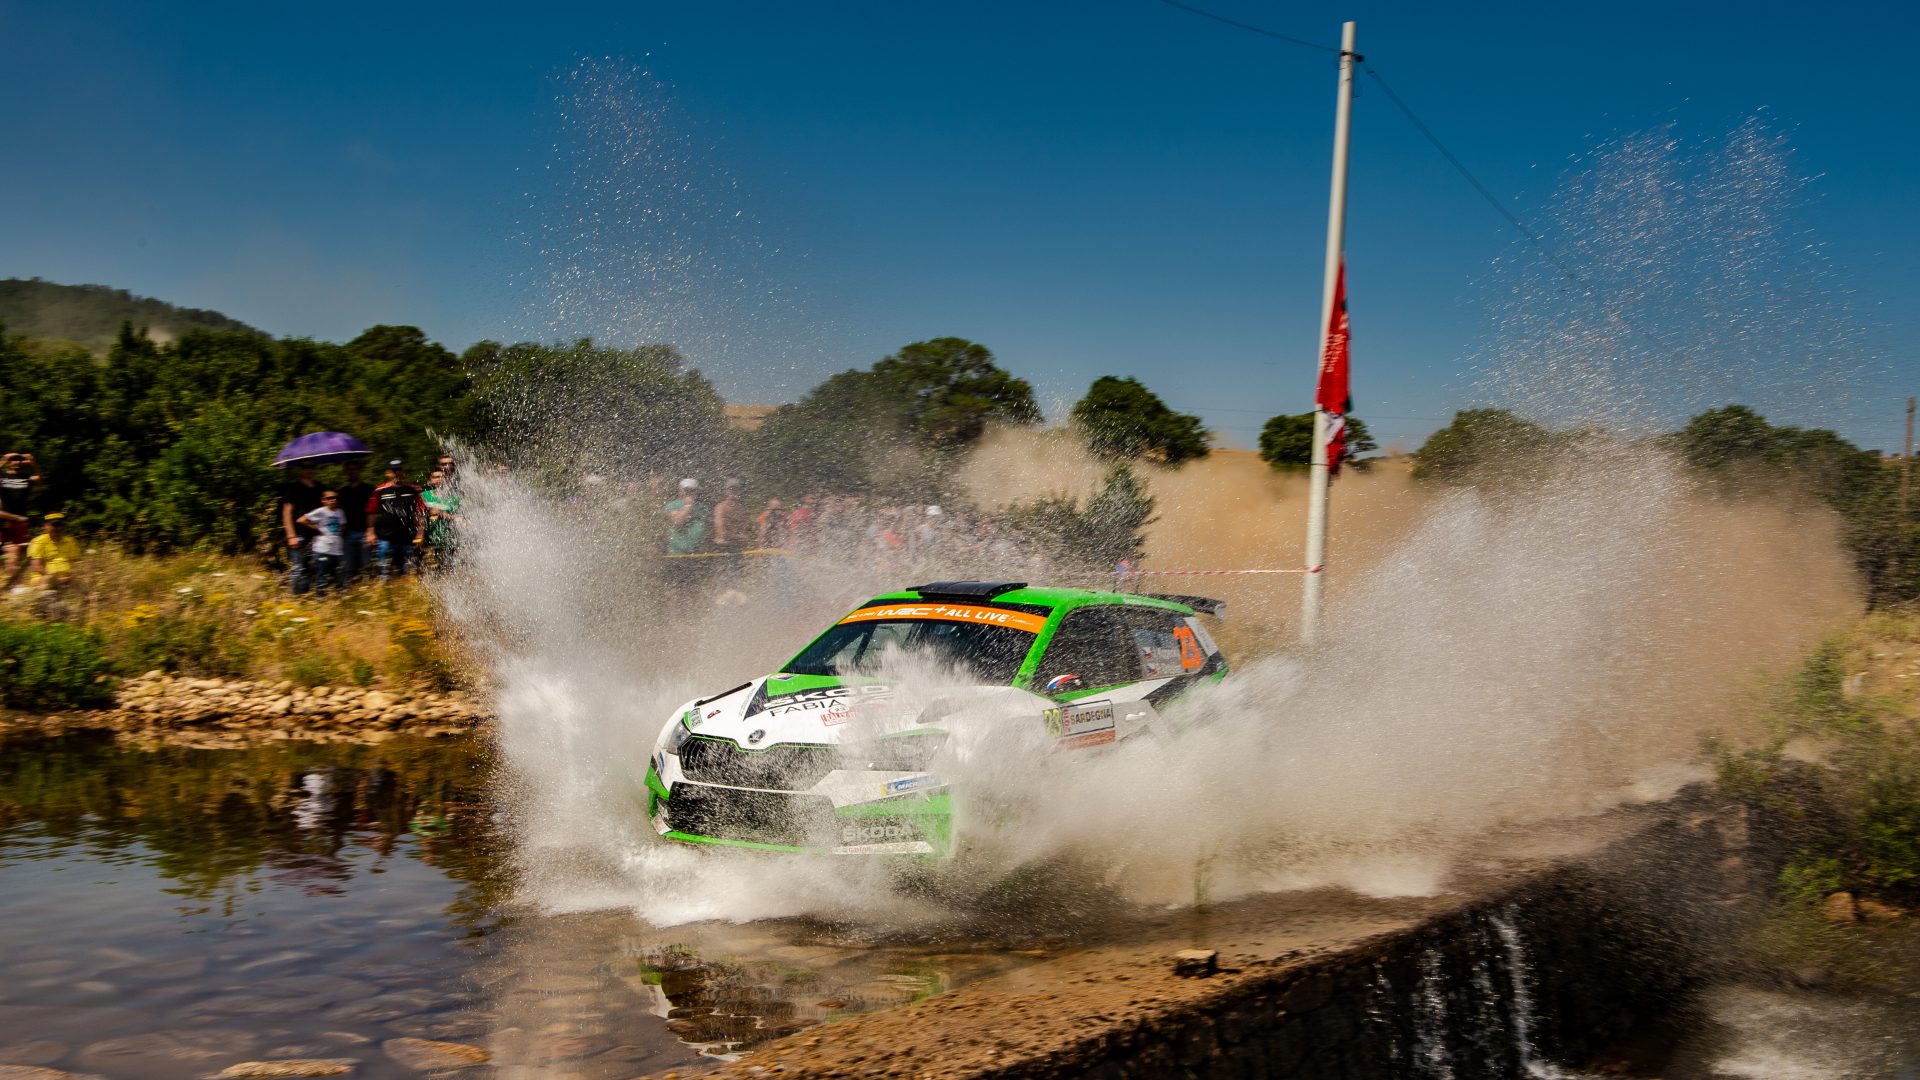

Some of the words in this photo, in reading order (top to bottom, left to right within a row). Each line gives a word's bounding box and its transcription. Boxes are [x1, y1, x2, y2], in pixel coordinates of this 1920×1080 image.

[876, 607, 934, 617] WRC
[944, 607, 971, 618] ALL
[974, 611, 1010, 623] LIVE
[769, 698, 844, 717] FABIA
[1070, 708, 1112, 725] SARDEGNA
